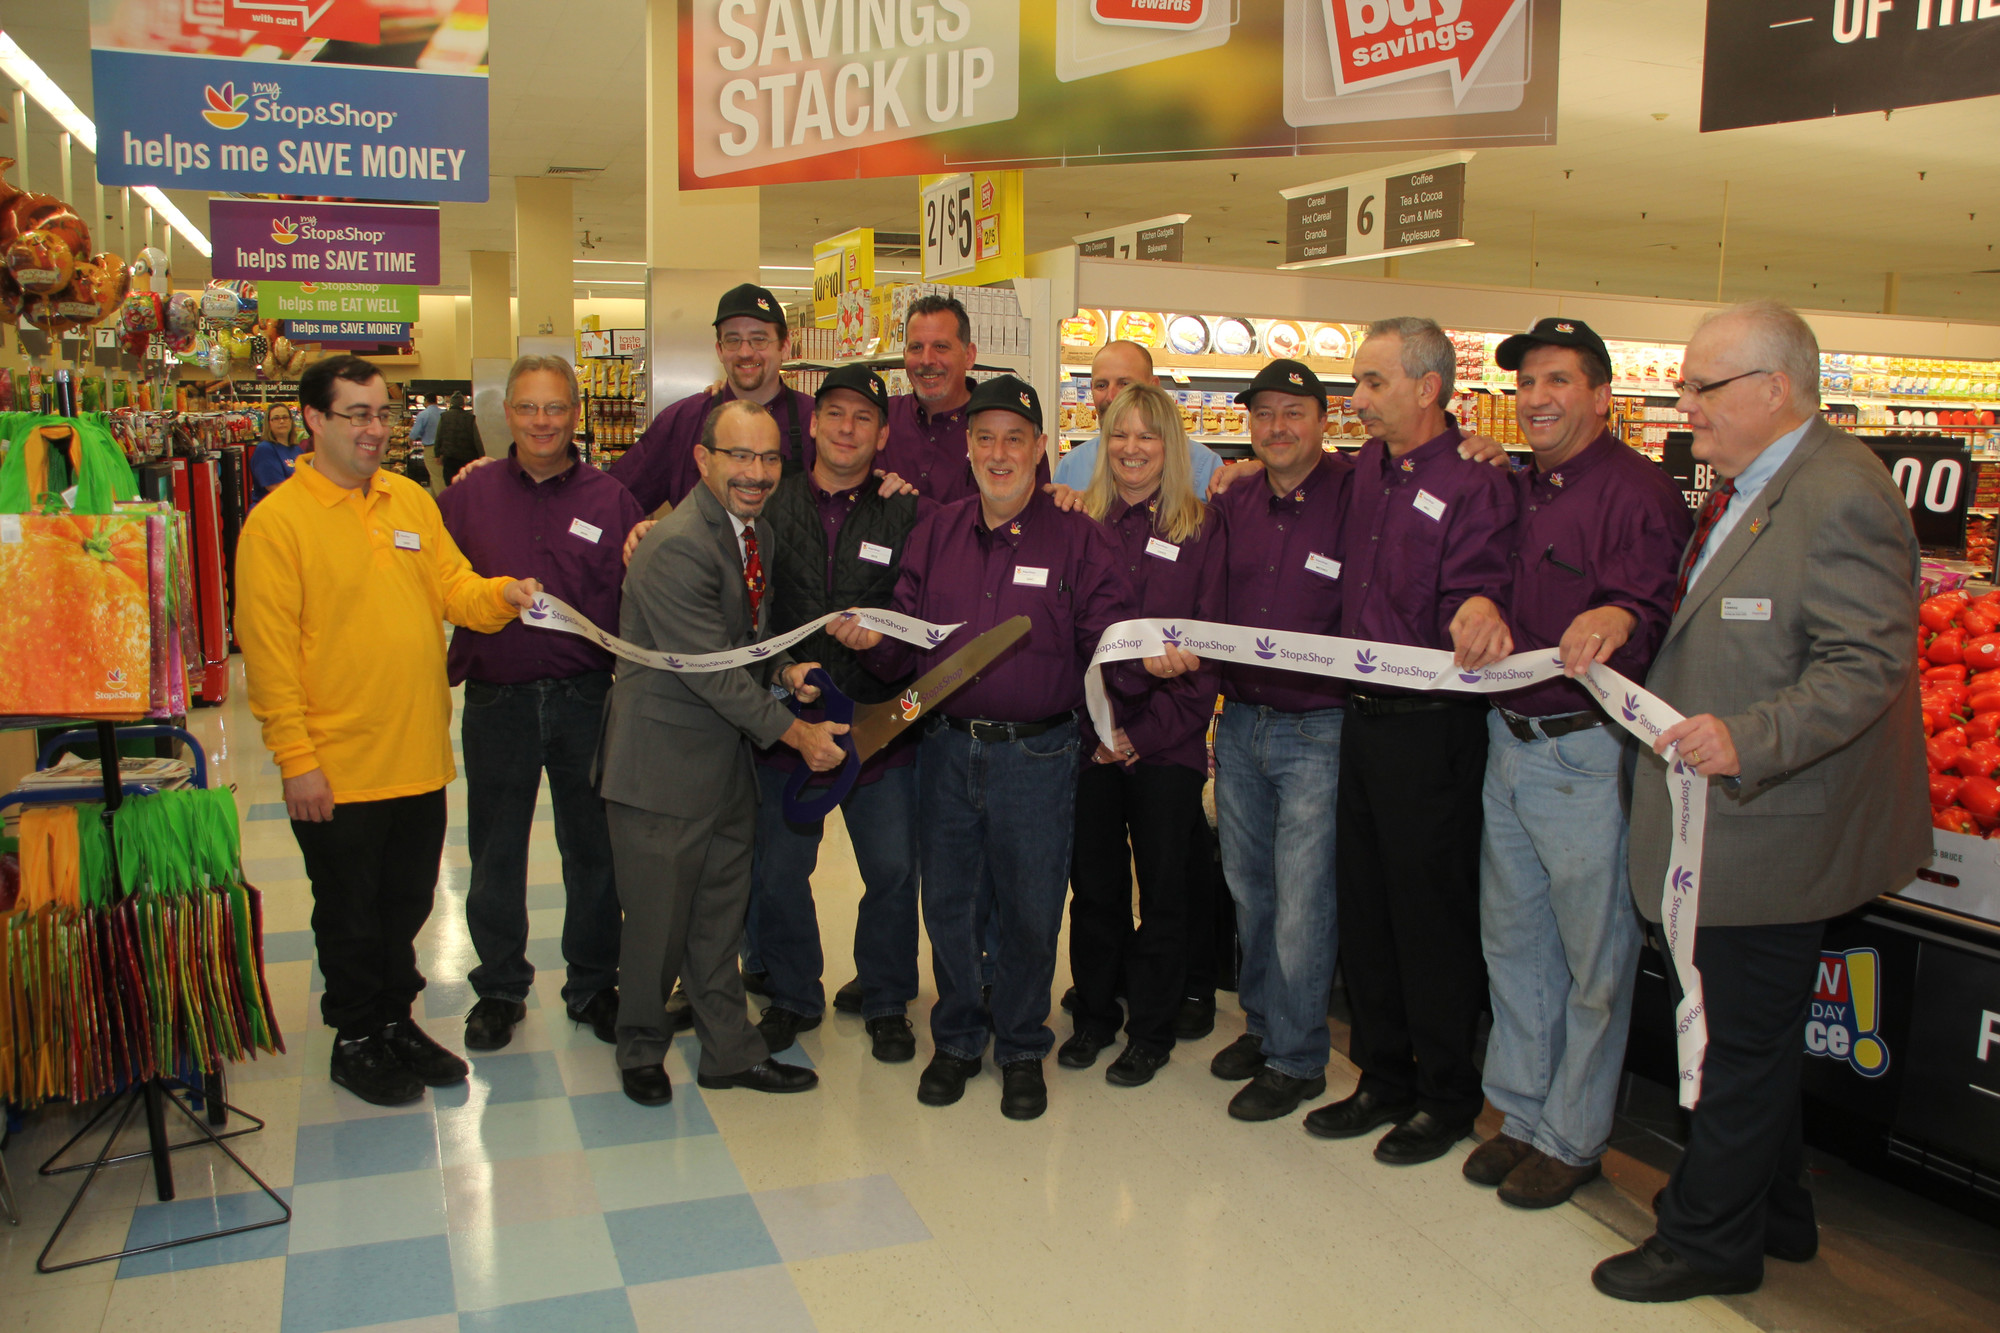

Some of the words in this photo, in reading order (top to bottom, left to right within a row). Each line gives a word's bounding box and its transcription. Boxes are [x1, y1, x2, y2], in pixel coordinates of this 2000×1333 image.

[1130, 0, 1192, 12] rewards
[252, 13, 273, 24] with
[276, 15, 298, 26] card
[1350, 0, 1464, 38] buy
[718, 0, 971, 71] SAVINGS
[1352, 20, 1475, 68] savings
[252, 80, 282, 99] my
[719, 56, 912, 157] STACK
[925, 47, 995, 123] UP
[254, 98, 396, 133] Stop&Shop
[123, 131, 210, 175] helps
[221, 146, 269, 172] me
[279, 140, 353, 176] SAVE
[362, 144, 466, 181] MONEY
[1411, 173, 1434, 186] Coffee
[1307, 195, 1327, 208] Cereal
[1400, 195, 1412, 206] Tea
[1413, 194, 1420, 204] &
[1420, 190, 1443, 202] Cocoa
[300, 215, 318, 226] my
[1302, 214, 1312, 225] Hot
[1313, 210, 1332, 223] Cereal
[1357, 195, 1375, 236] 6
[1400, 213, 1416, 225] Gum
[1417, 212, 1423, 221] &
[1423, 208, 1443, 220] Mints
[302, 226, 384, 244] Stop&Shop
[927, 187, 972, 266] 2/$5
[1141, 231, 1156, 241] Kitchen
[1157, 227, 1174, 238] Gadgets
[1304, 228, 1327, 241] Granola
[1400, 227, 1441, 244] Applesauce
[1147, 243, 1168, 254] Bakeware
[1303, 244, 1328, 257] Oatmeal
[237, 247, 287, 272] helps
[292, 253, 320, 269] me
[325, 250, 369, 271] SAVE
[373, 252, 417, 273] TIME
[279, 296, 314, 314] helps
[317, 300, 337, 312] me
[341, 298, 363, 312] EAT
[366, 298, 401, 314] WELL
[101, 331, 109, 343] 7
[292, 321, 320, 335] helps
[322, 324, 338, 334] me
[340, 322, 365, 335] SAVE
[367, 322, 402, 336] MONEY
[619, 335, 641, 344] taste
[151, 346, 158, 357] 9
[1694, 463, 1715, 490] BE
[1682, 490, 1708, 509] EEK
[1183, 636, 1235, 654] Stop&Shop
[1280, 648, 1334, 666] Stop&Shop
[1380, 661, 1437, 681] Stop&Shop
[1483, 668, 1533, 683] Stop&Shop
[1679, 778, 1692, 843] Stop&Shop
[1940, 850, 1963, 863] BRUCE
[1811, 1002, 1847, 1021] DAY
